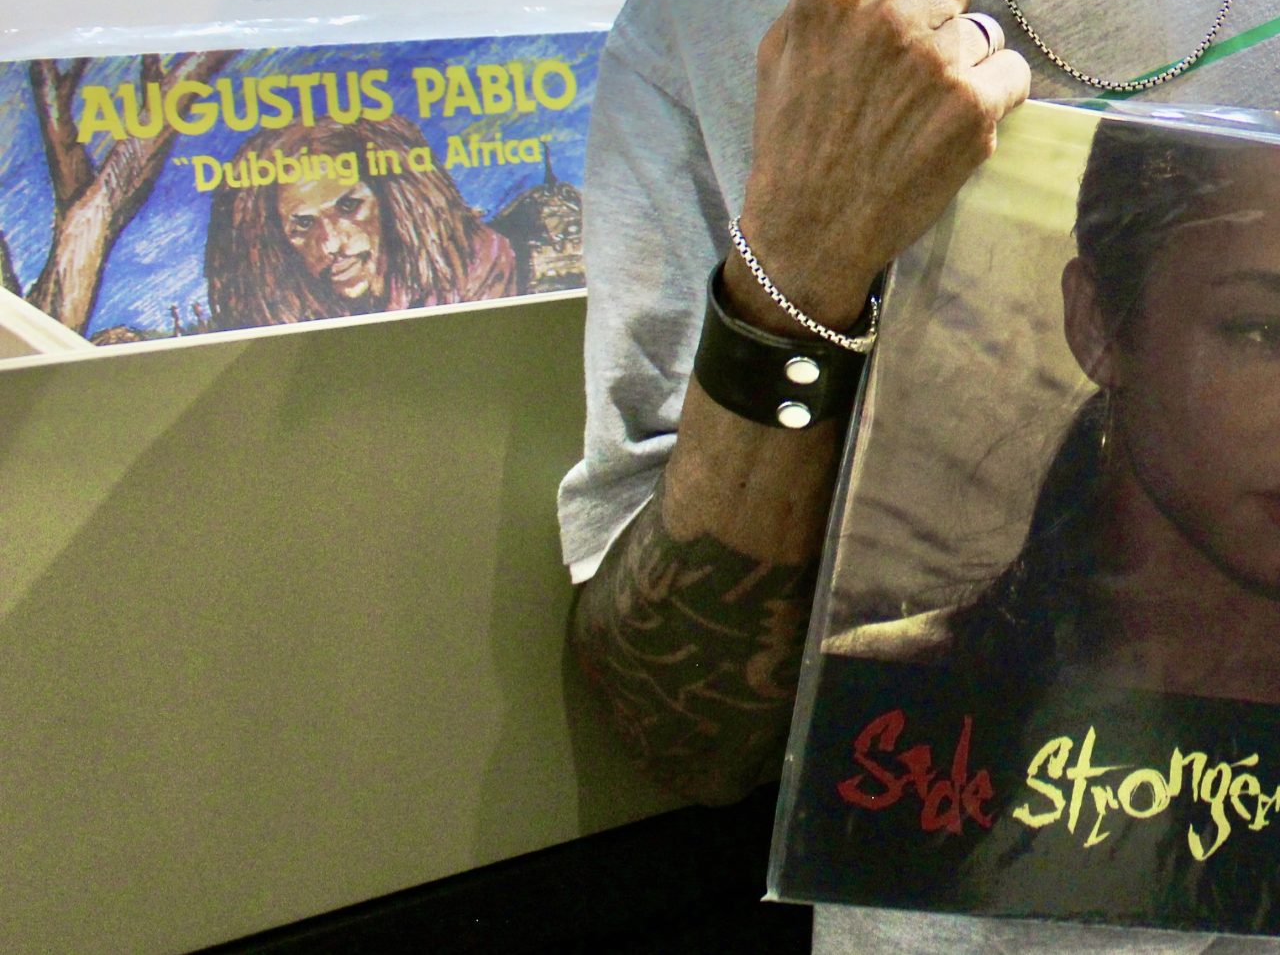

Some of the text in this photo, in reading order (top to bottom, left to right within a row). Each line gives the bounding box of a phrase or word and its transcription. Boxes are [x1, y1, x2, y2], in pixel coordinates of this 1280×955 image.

[76, 59, 578, 144] AUGUSTUS PABLO
[366, 141, 402, 176] in
[407, 145, 434, 173] a
[836, 708, 994, 836] Sade
